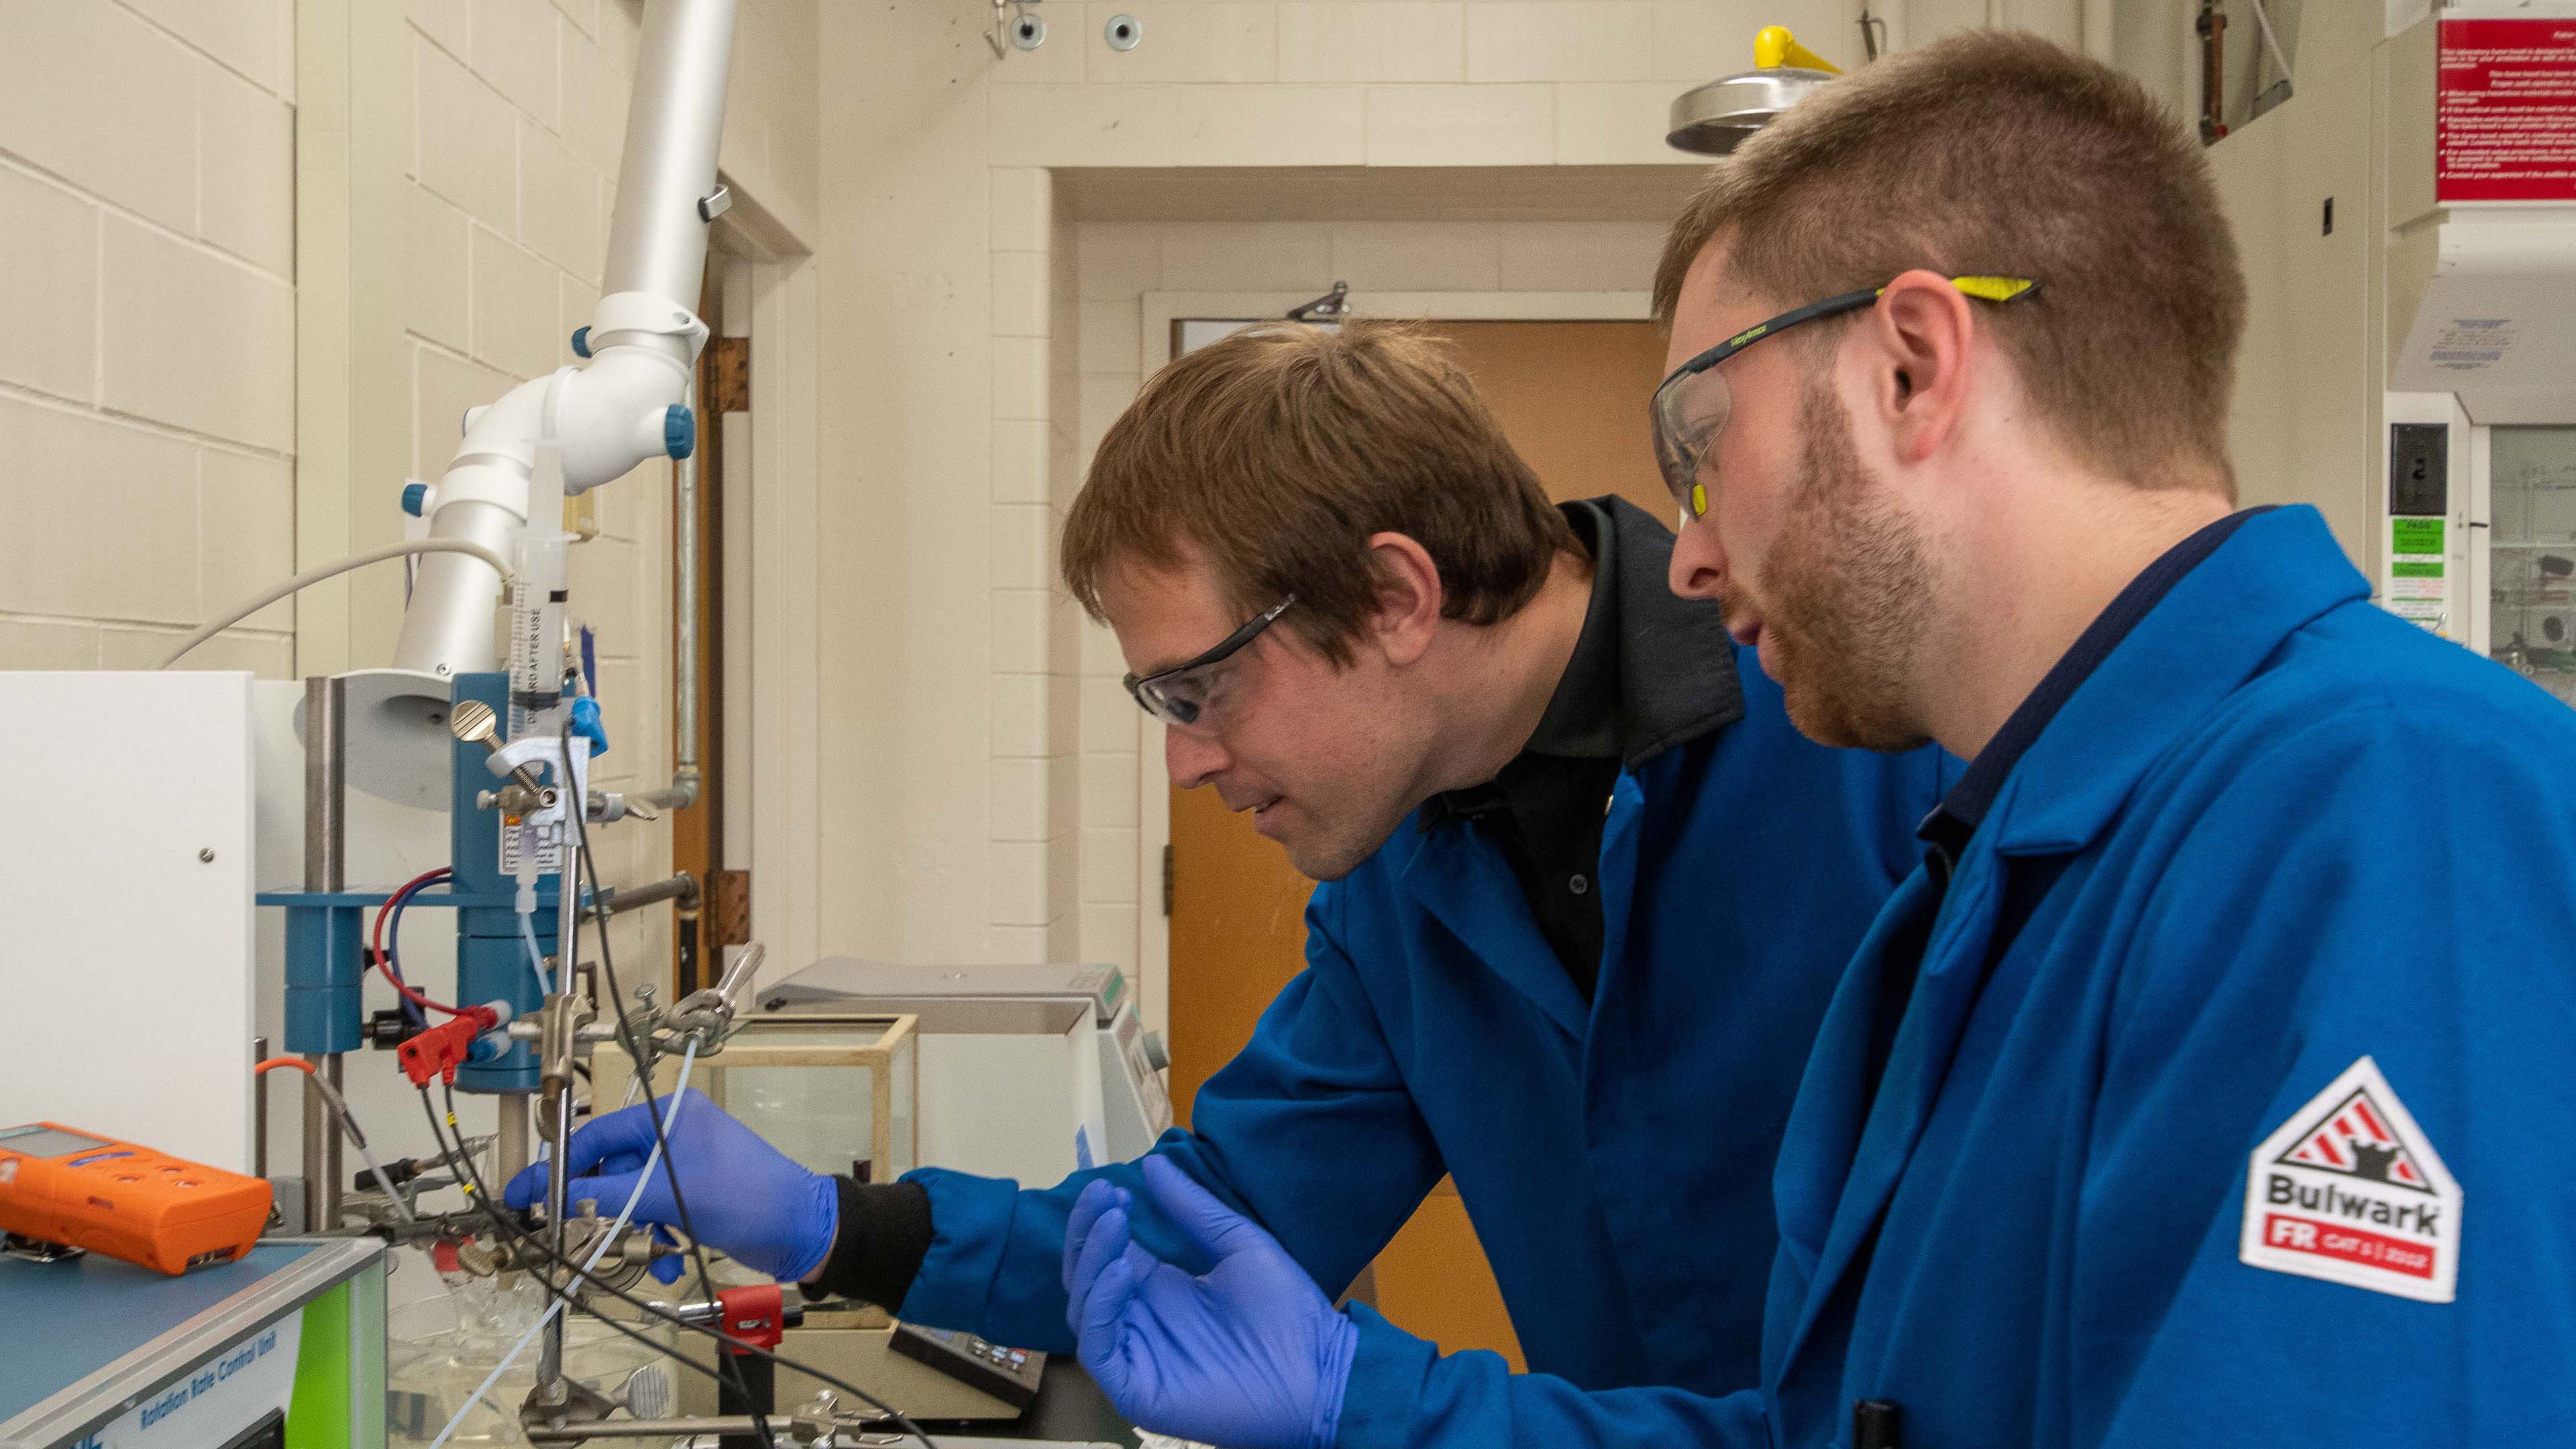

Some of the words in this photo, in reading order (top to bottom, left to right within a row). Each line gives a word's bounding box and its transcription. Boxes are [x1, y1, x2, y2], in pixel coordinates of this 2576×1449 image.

[530, 608, 541, 631] USE
[529, 633, 539, 671] AFTER
[2267, 1174, 2440, 1237] Bulwark
[2273, 1218, 2318, 1250] FR
[140, 1388, 189, 1431] Rotation
[191, 1371, 215, 1399] Rate
[217, 1341, 256, 1381] Control
[257, 1330, 277, 1358] Unit
